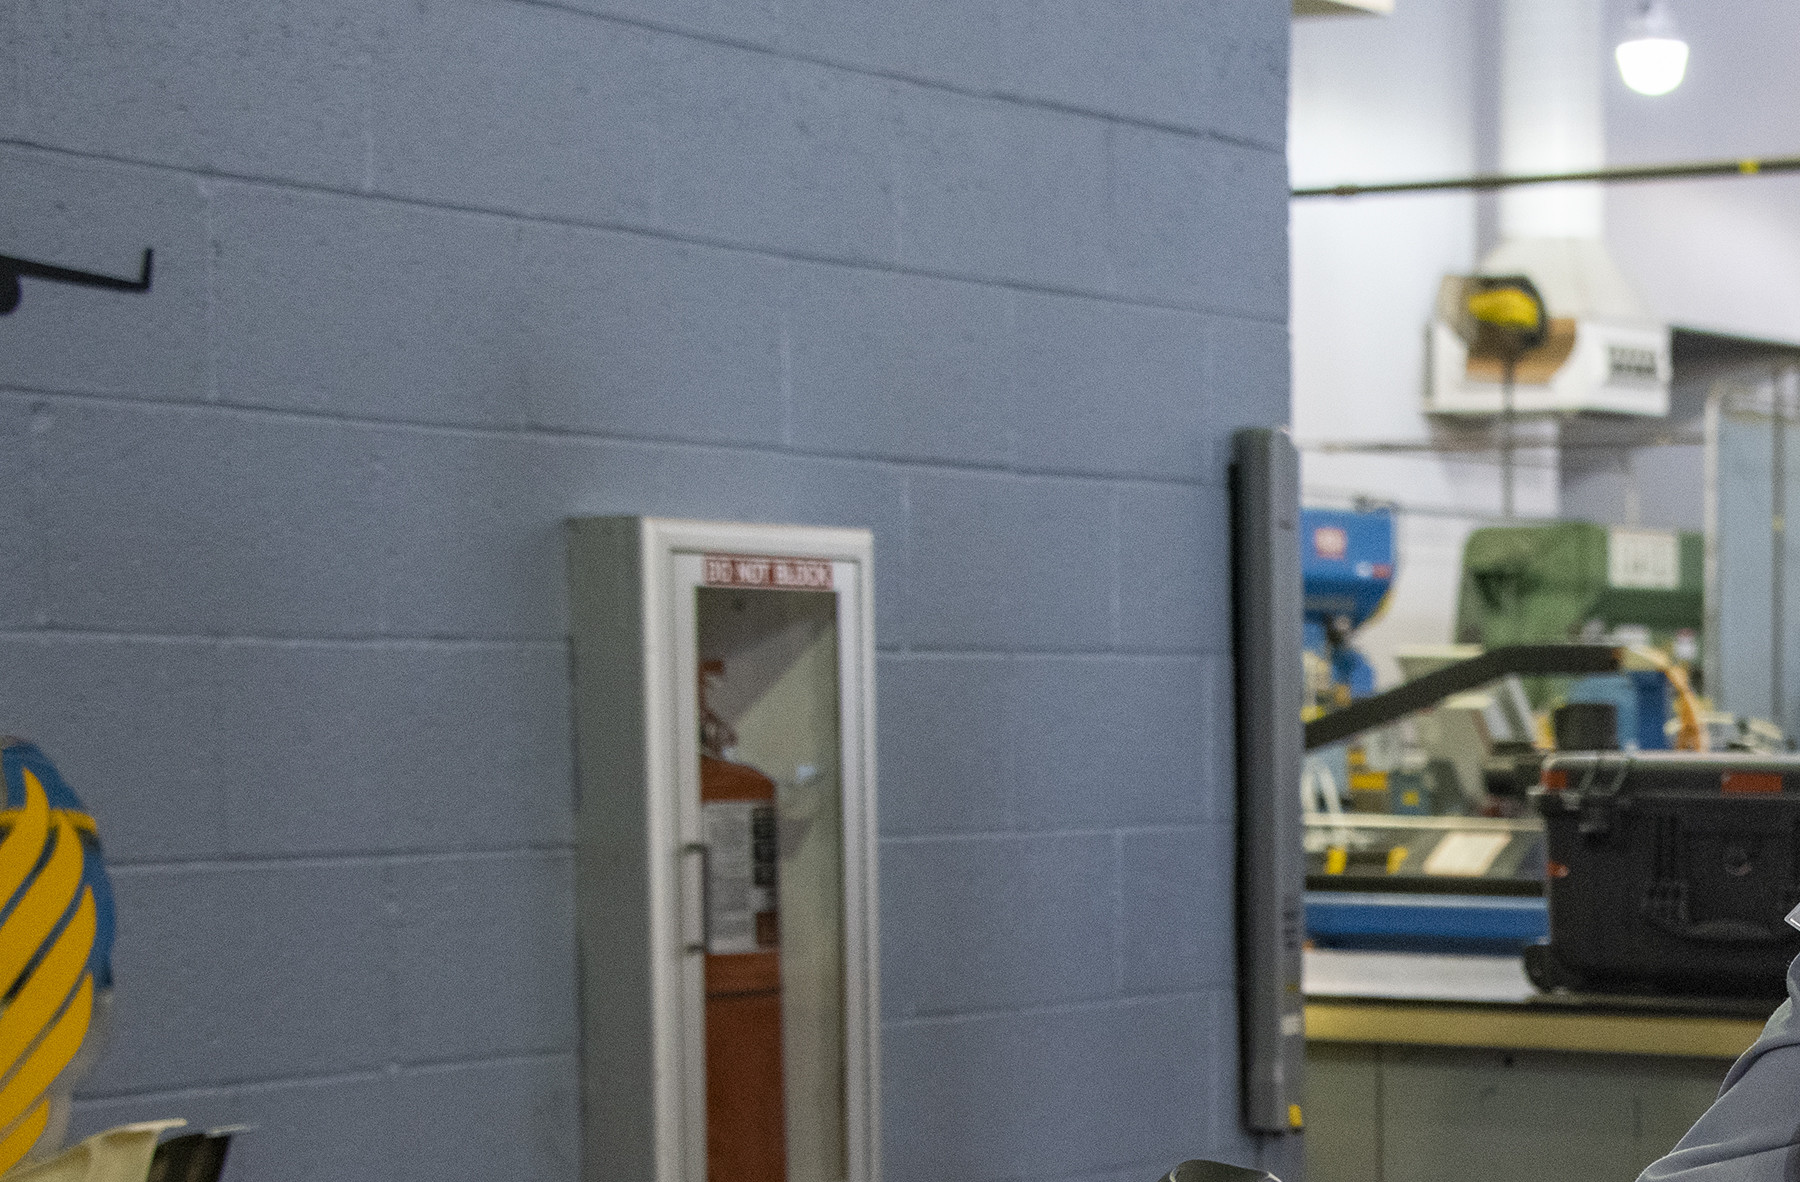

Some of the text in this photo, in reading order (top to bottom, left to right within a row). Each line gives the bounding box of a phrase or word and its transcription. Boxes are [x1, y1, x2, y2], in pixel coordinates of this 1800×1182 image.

[705, 560, 832, 586] DO NOT BLOCK
